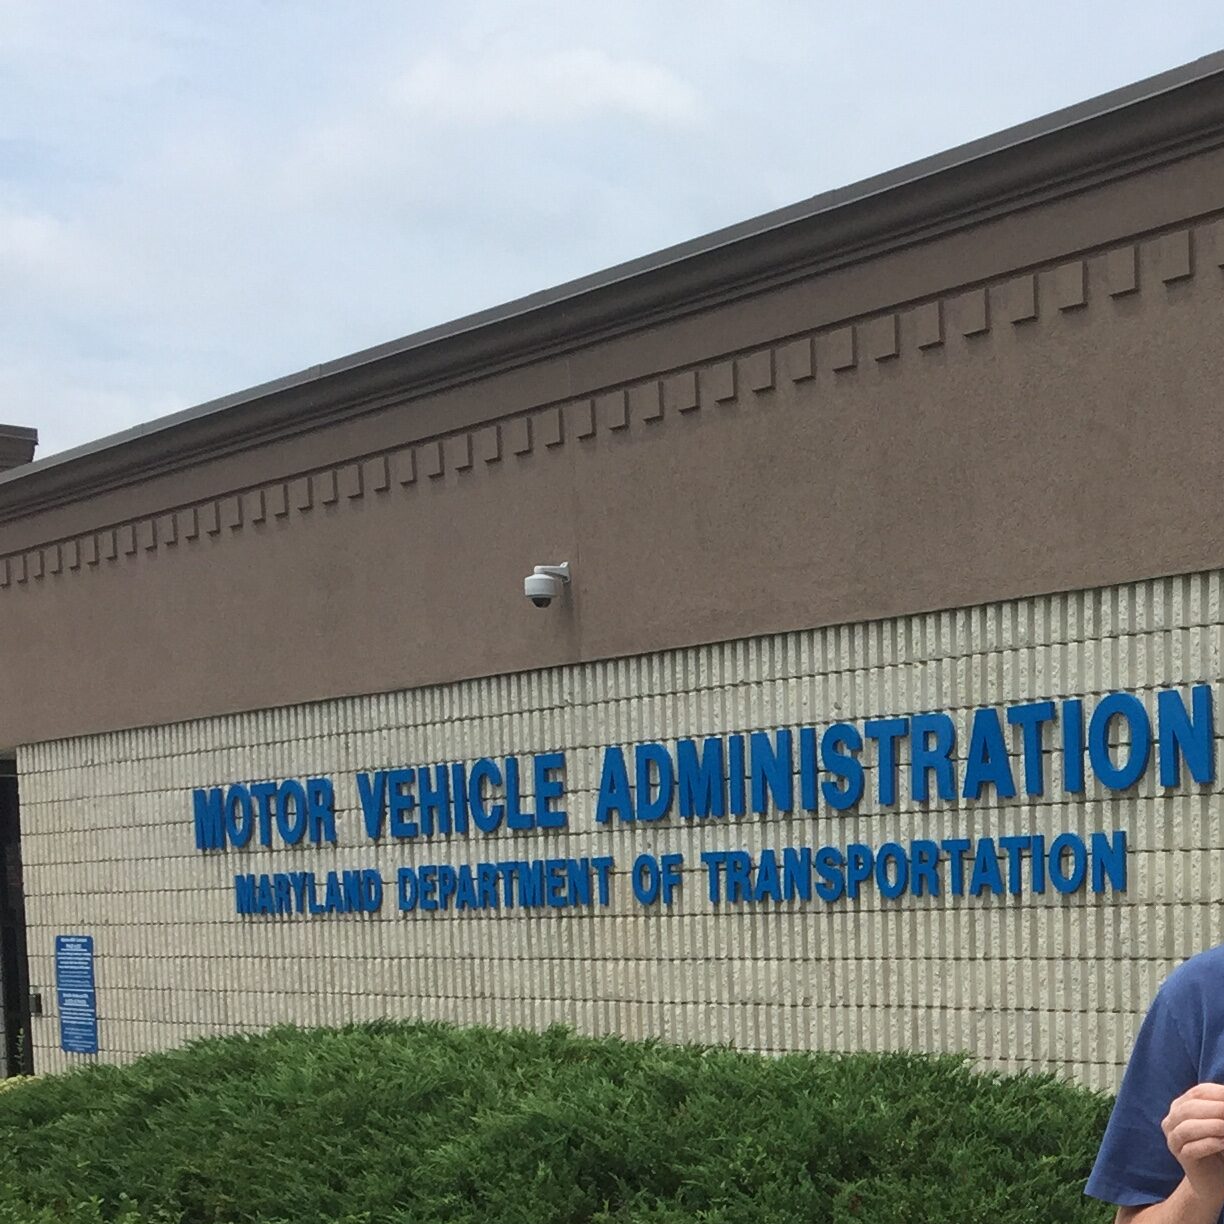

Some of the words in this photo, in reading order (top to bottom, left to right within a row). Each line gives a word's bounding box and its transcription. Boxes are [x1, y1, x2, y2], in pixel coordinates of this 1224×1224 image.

[193, 776, 337, 850] MOTOR
[357, 752, 567, 840] VEHICLE
[595, 683, 1215, 824] ADMINISTRATION
[234, 868, 383, 915] MARYLAND
[397, 856, 614, 913] DEPARTMENT
[632, 853, 684, 906] OF
[701, 830, 1127, 904] TRANSPORTATION
